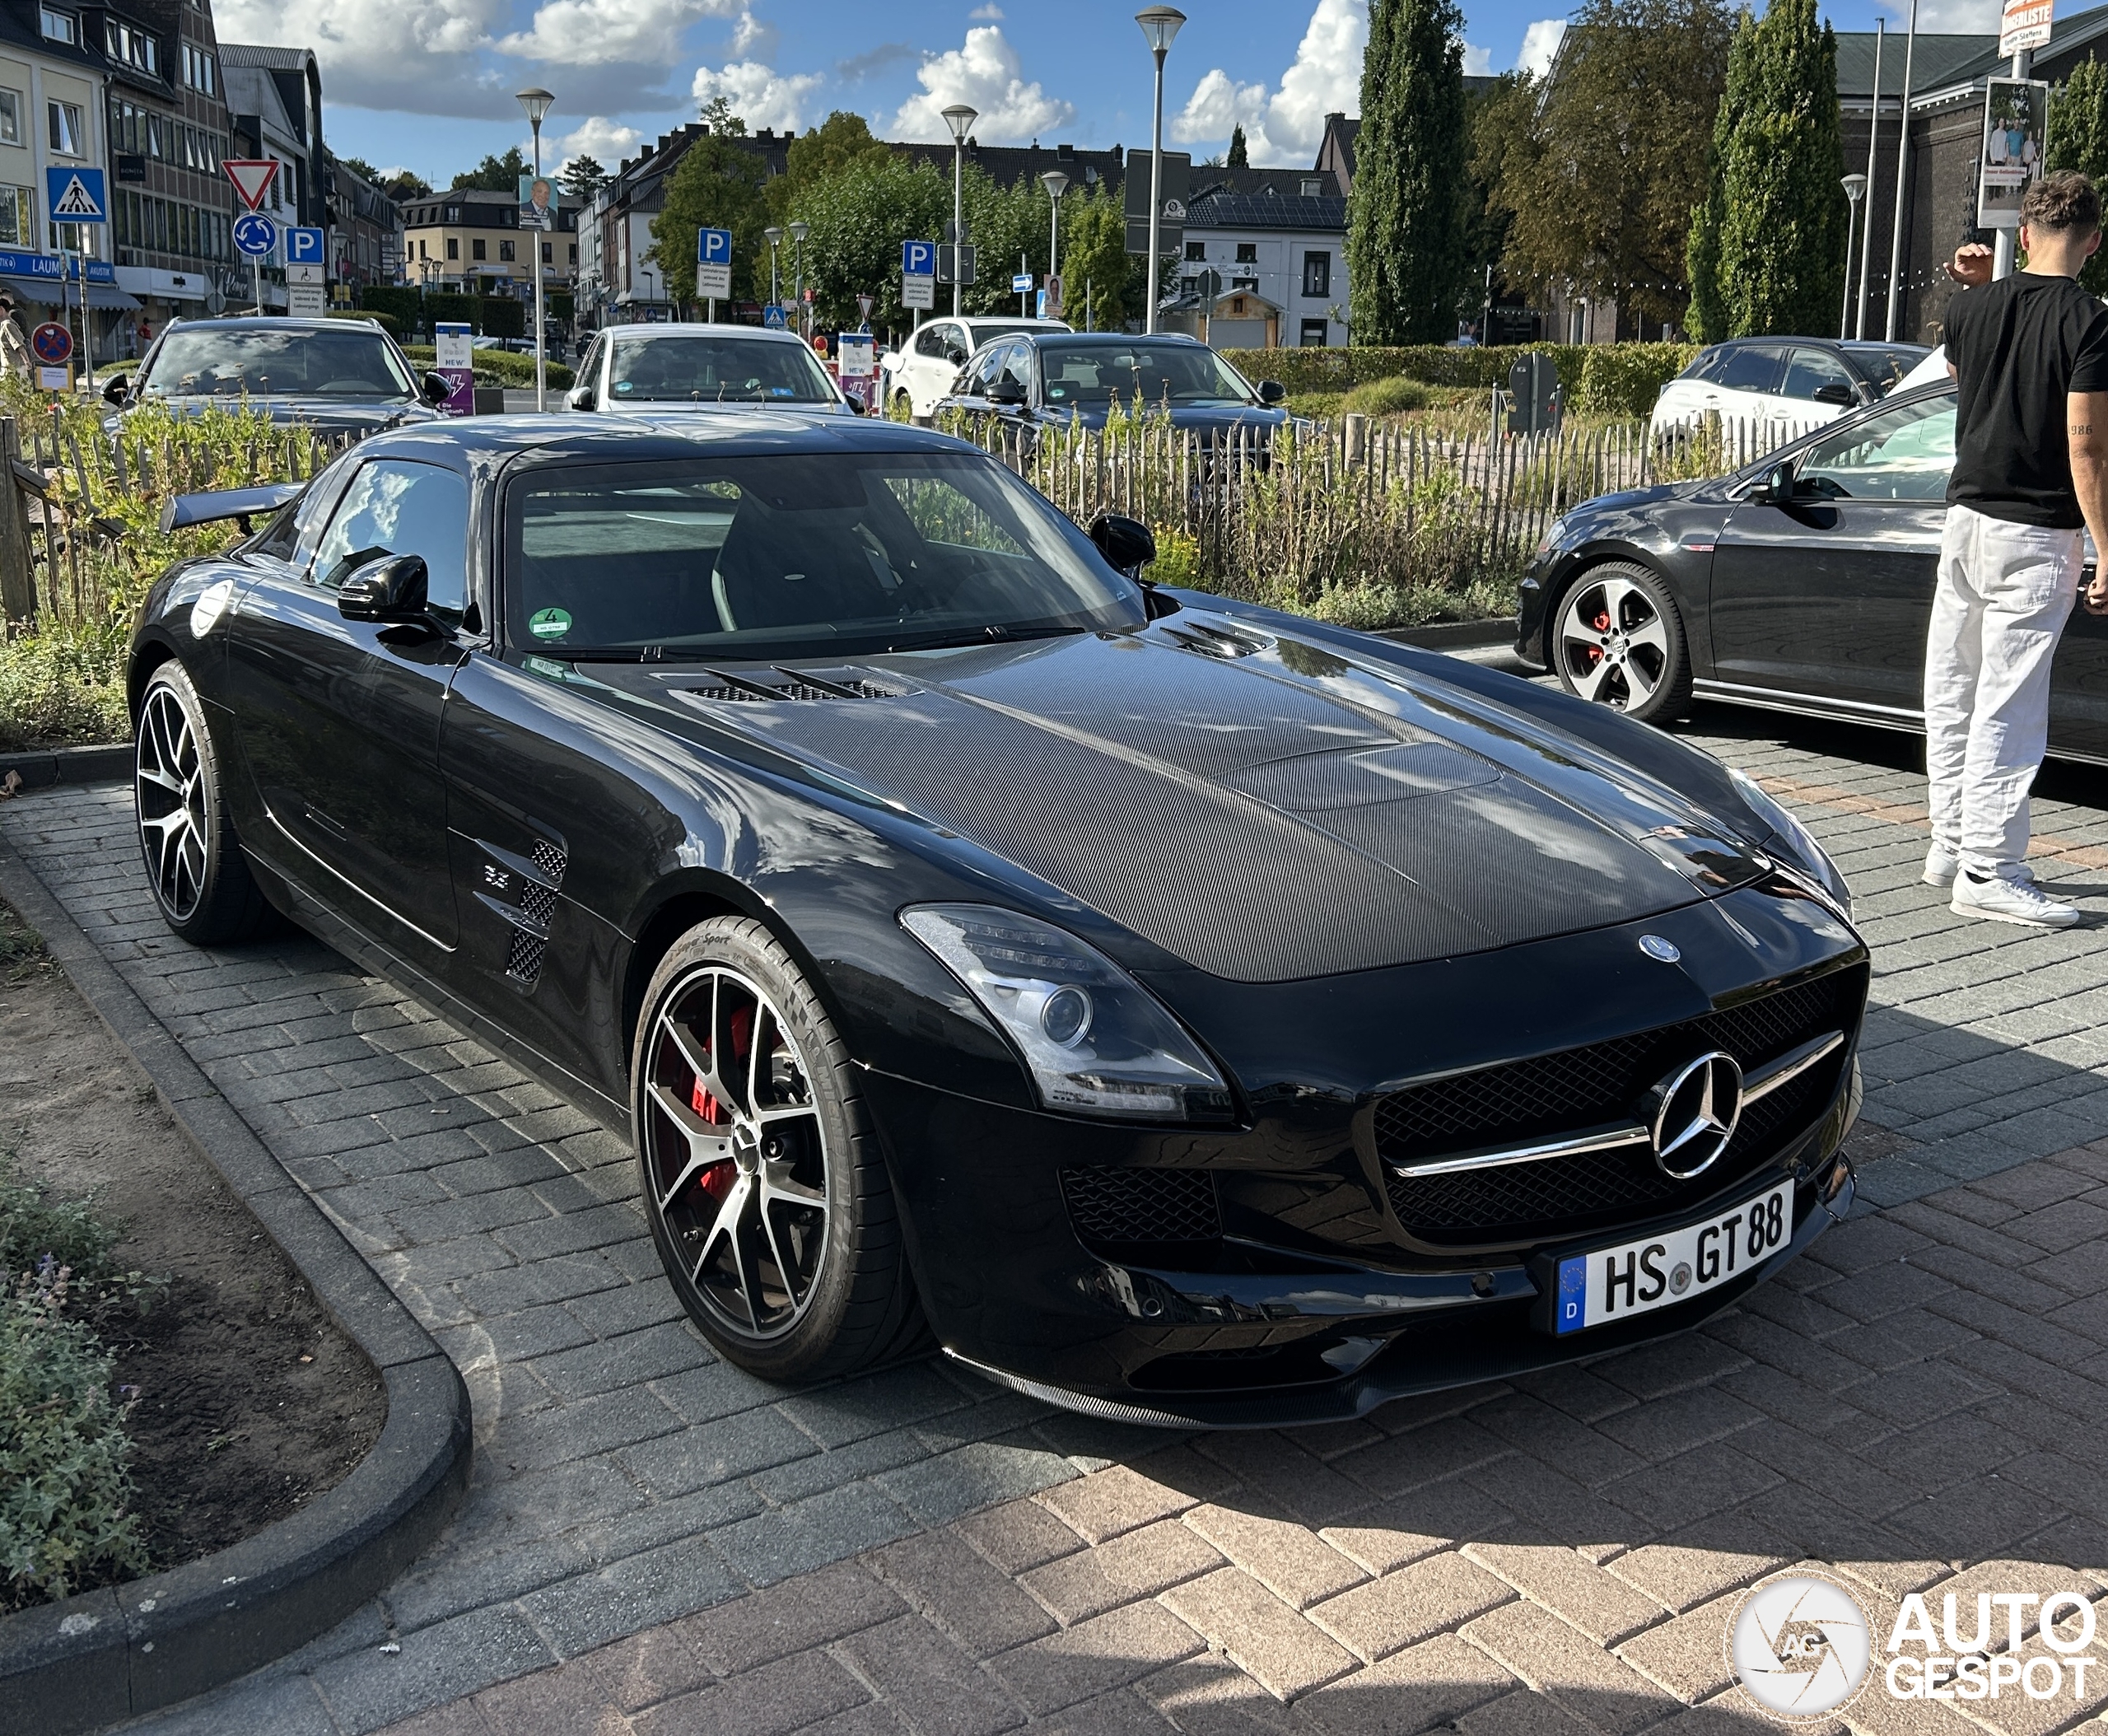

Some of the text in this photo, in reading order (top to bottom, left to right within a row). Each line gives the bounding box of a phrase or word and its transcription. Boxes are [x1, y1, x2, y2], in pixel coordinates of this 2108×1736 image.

[295, 232, 315, 259] P
[706, 232, 724, 259] P
[32, 258, 60, 274] LAUM
[910, 245, 927, 270] P
[90, 266, 110, 276] AKUSTIK
[544, 609, 557, 623] 4
[702, 932, 731, 946] Sport
[1605, 1192, 1784, 1314] HS GT88
[1566, 1302, 1578, 1320] D
